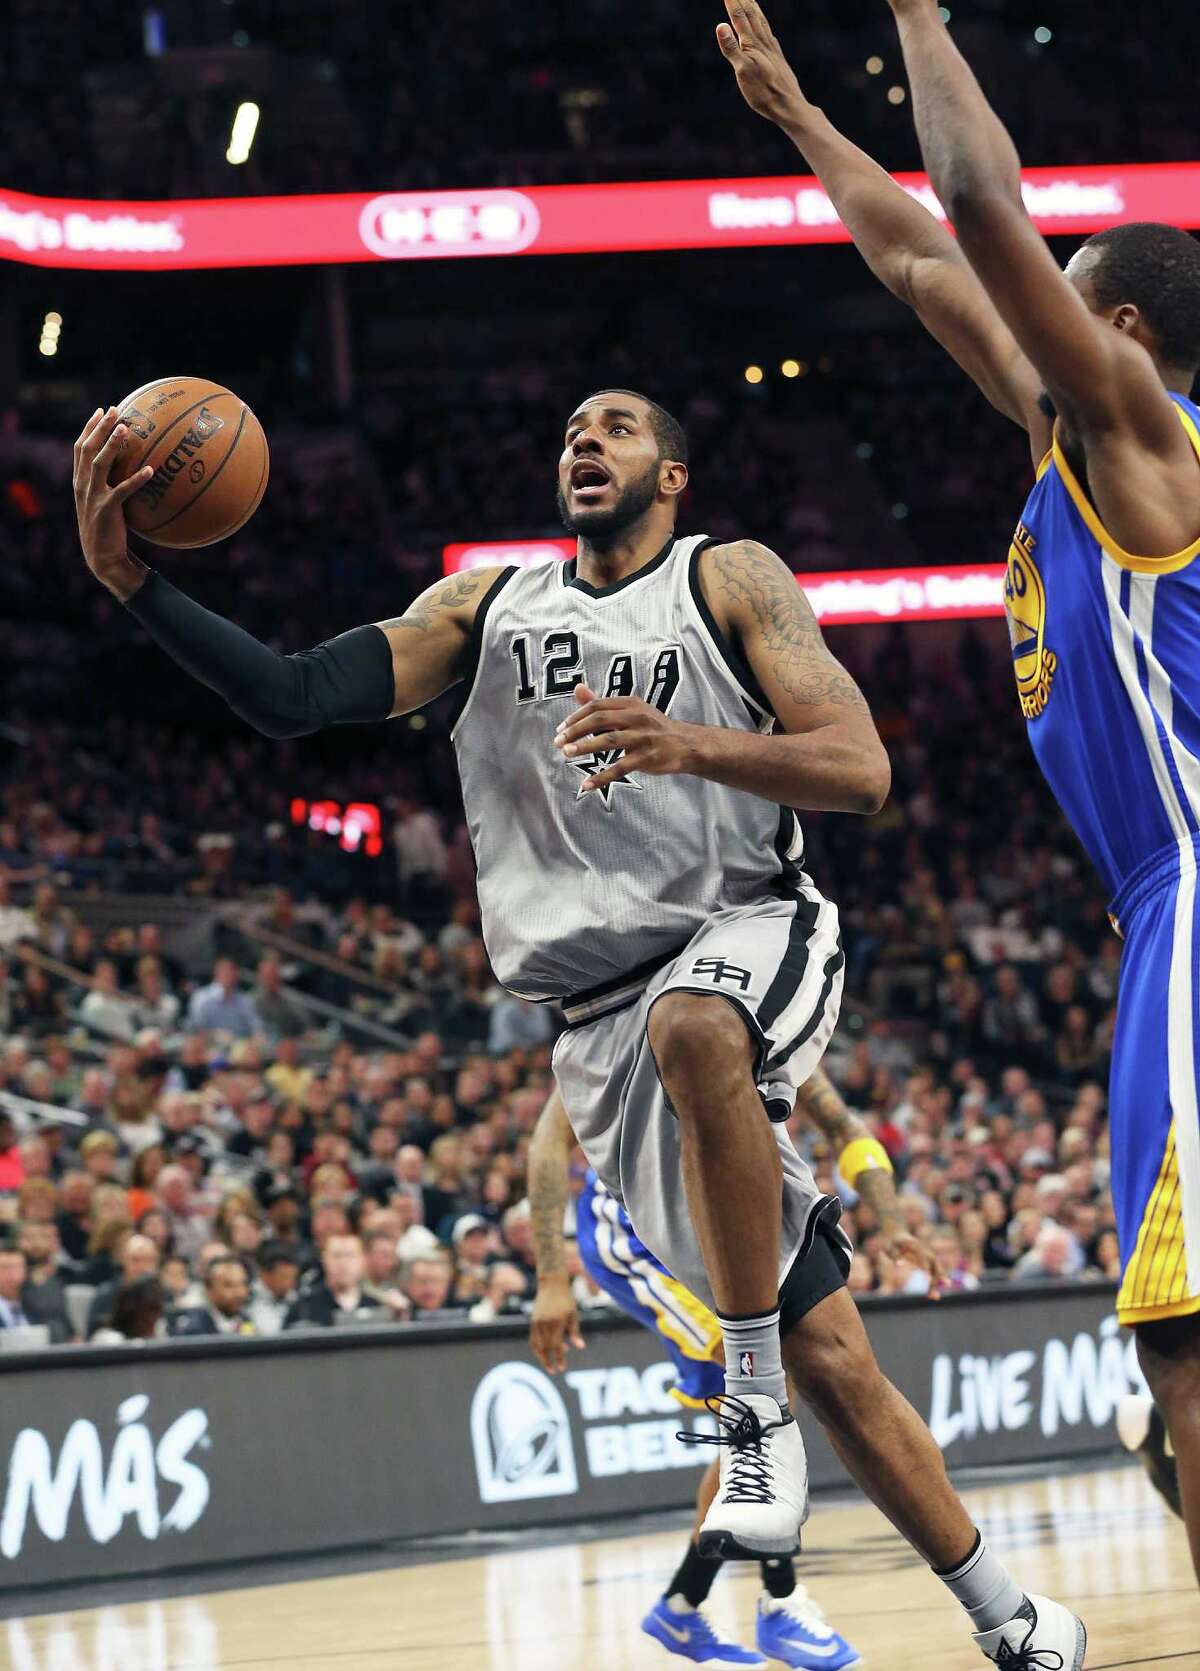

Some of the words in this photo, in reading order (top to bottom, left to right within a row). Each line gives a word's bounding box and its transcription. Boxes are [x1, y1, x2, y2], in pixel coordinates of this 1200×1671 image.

[510, 629, 585, 705] 12
[1018, 648, 1057, 718] RRIORS
[565, 1361, 683, 1420] TAC
[0, 1393, 210, 1559] MÁS
